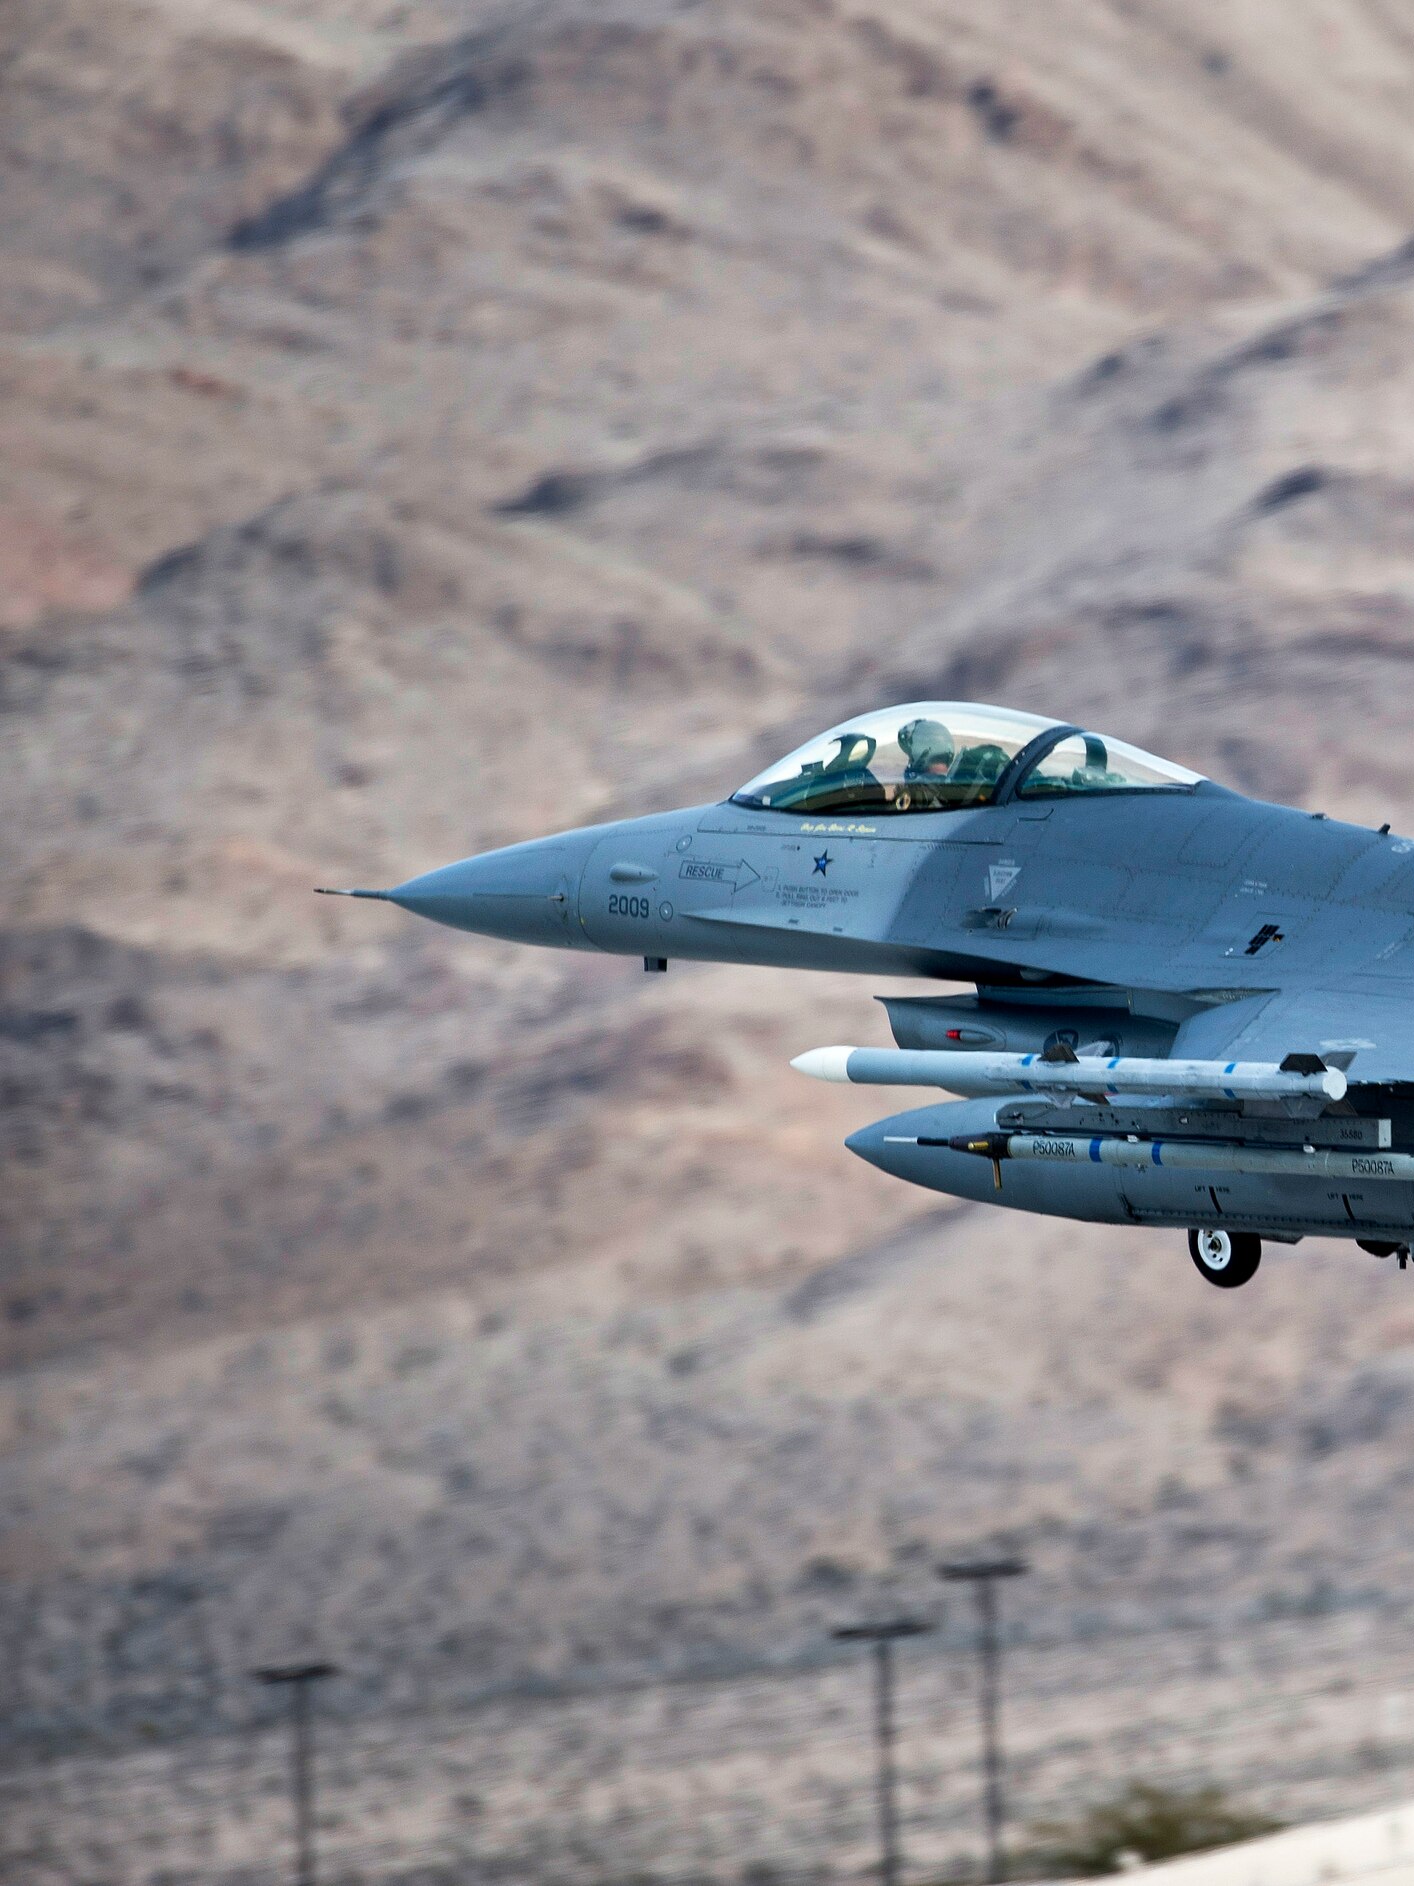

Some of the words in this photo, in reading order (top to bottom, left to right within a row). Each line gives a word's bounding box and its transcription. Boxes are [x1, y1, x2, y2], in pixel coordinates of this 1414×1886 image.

[685, 865, 725, 879] RESCUE
[608, 894, 650, 919] 2009
[1032, 1140, 1076, 1158] P50087A
[1351, 1158, 1395, 1175] P50087A
